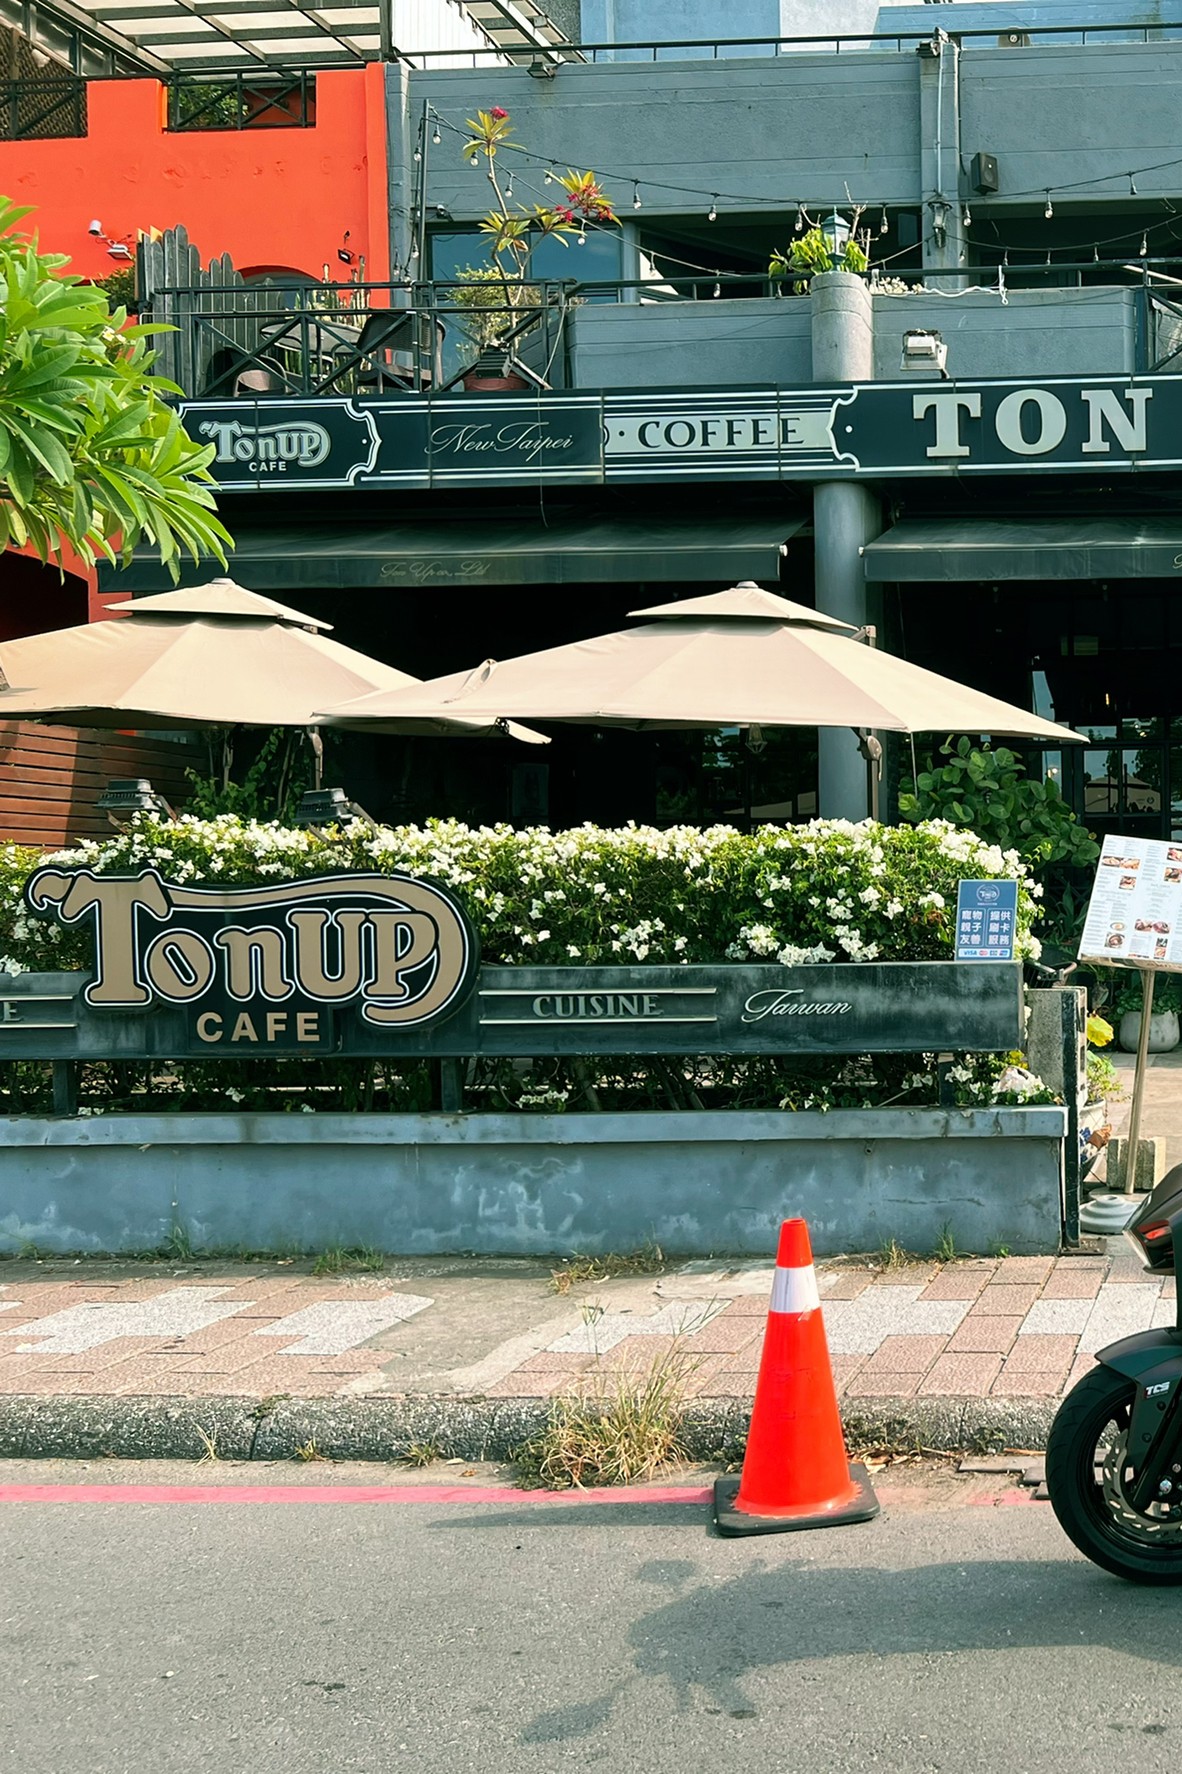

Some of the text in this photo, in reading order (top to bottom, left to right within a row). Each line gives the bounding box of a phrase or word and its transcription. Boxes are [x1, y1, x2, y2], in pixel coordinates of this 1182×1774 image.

[638, 417, 805, 448] COFFEE
[912, 388, 1153, 457] TON
[424, 421, 575, 462] New Taipei
[248, 461, 287, 472] CAFE
[533, 995, 664, 1018] CUISINE
[741, 989, 853, 1023] Taiwan
[197, 1012, 321, 1042] CAFE
[1145, 1381, 1170, 1395] TCS
